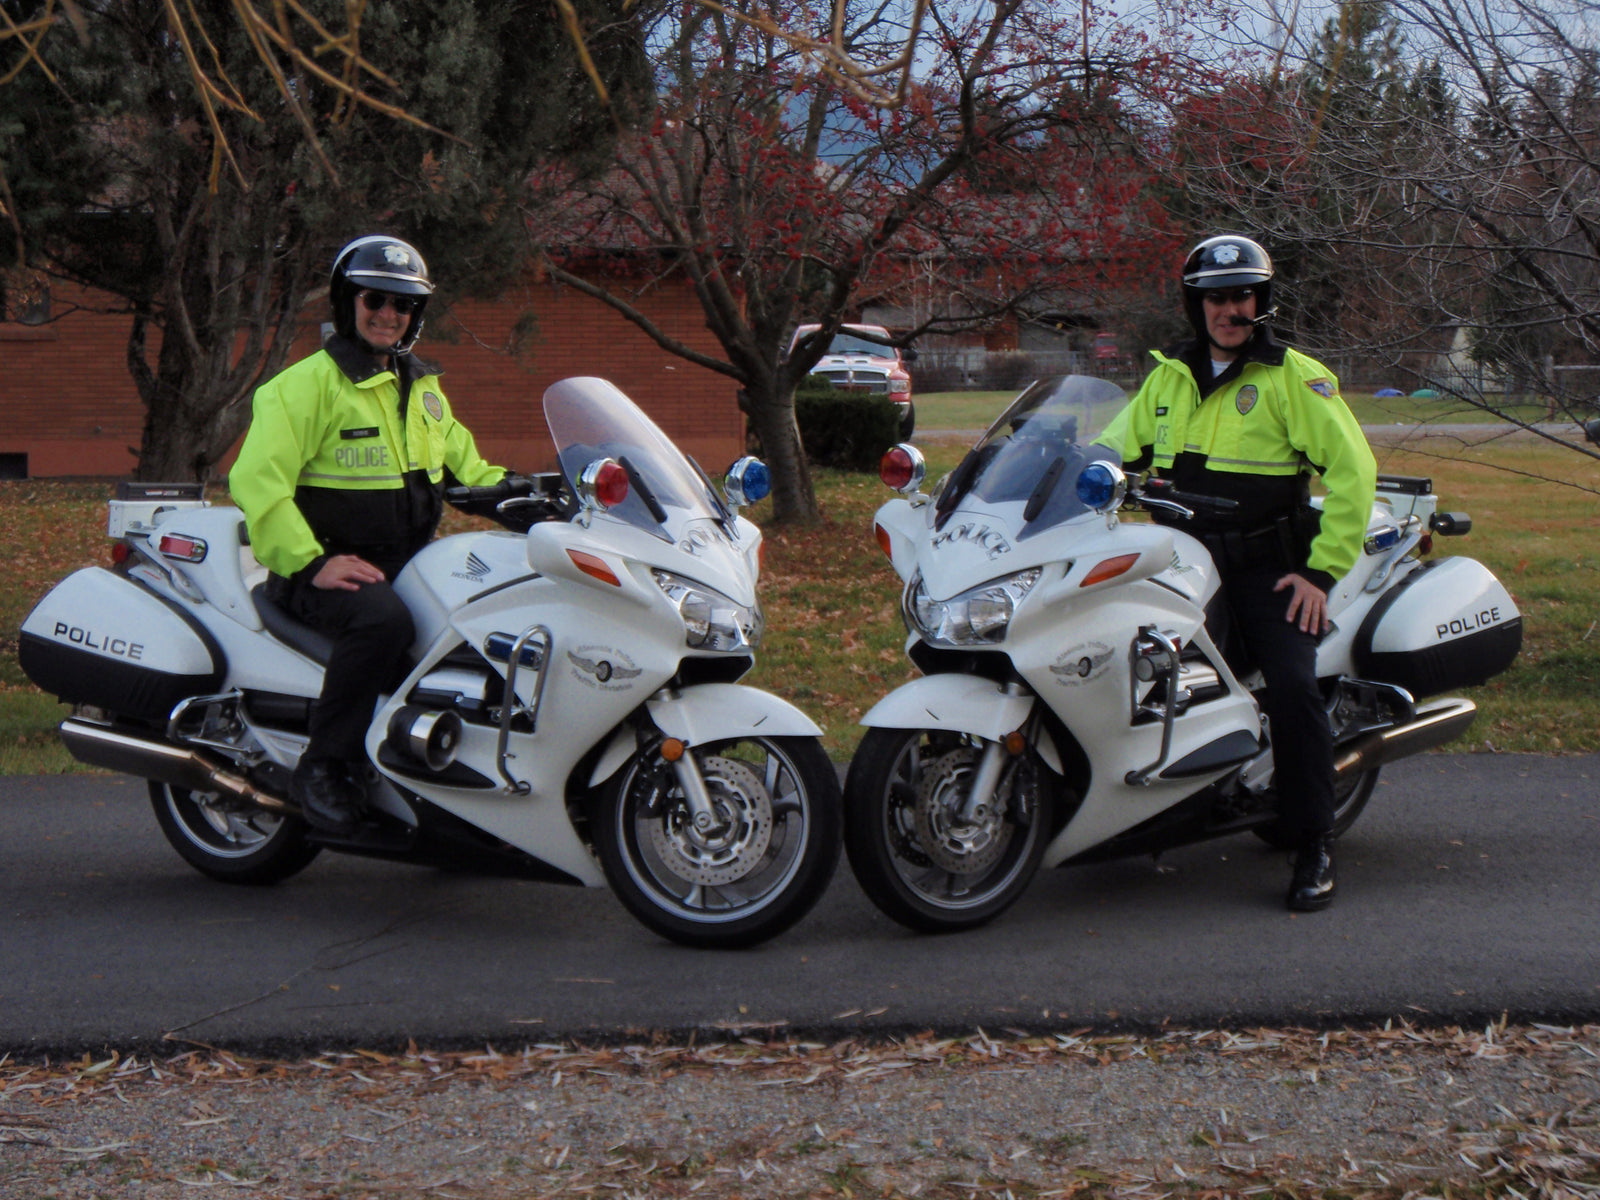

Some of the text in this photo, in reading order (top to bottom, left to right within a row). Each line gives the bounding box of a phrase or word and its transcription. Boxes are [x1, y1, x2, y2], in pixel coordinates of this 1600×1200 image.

[334, 446, 389, 469] POLICE
[930, 522, 1012, 561] POLICE
[53, 621, 144, 660] POLICE
[1435, 606, 1501, 640] POLICE
